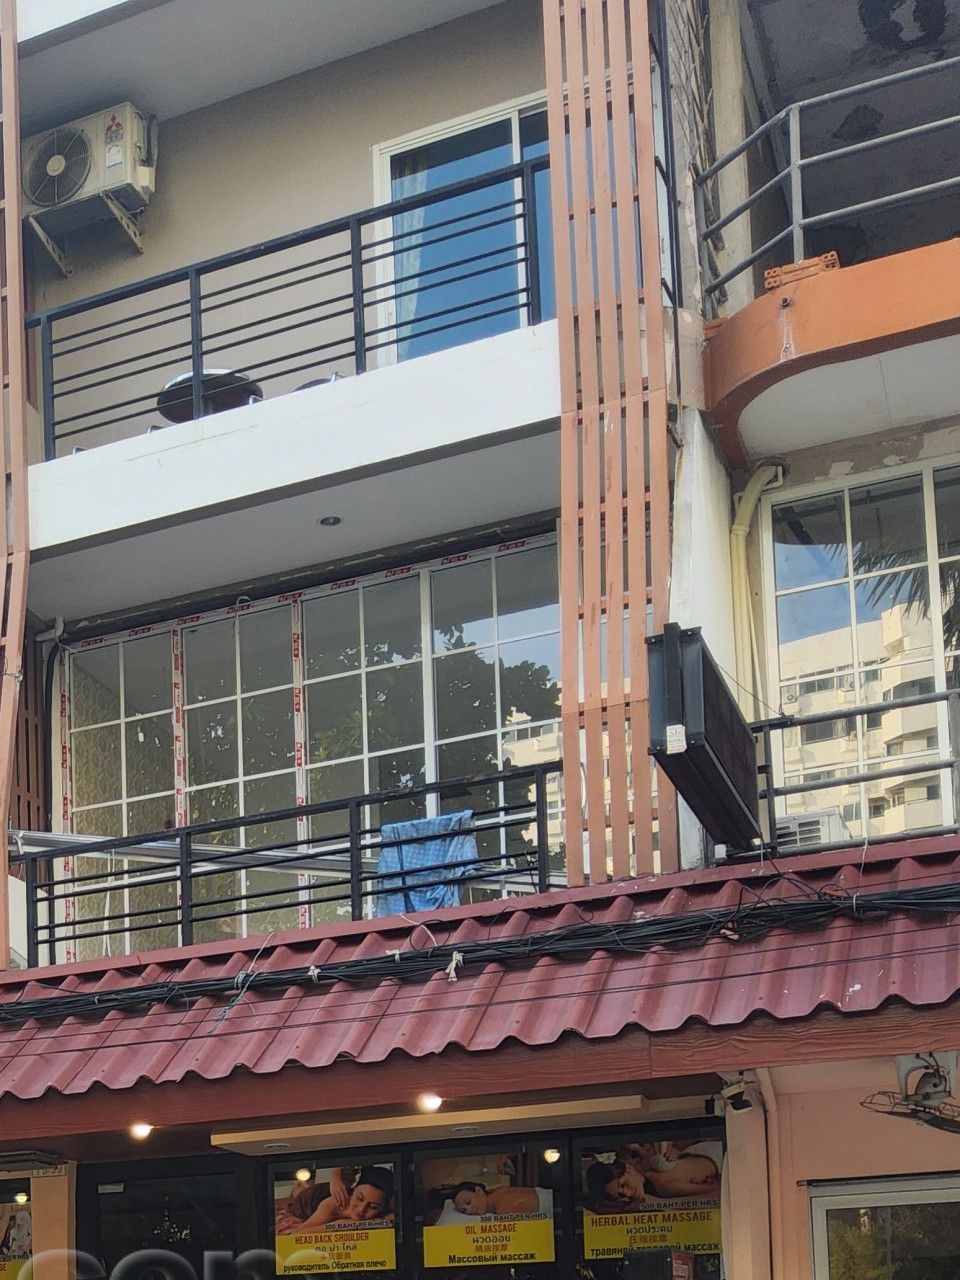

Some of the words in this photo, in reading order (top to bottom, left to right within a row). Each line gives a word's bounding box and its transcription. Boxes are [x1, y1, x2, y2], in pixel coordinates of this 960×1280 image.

[591, 1216, 630, 1227] HERBAL
[633, 1214, 658, 1225] HEAT
[662, 1211, 712, 1223] MASSAGE
[465, 1226, 477, 1235] OIL
[480, 1223, 517, 1234] MASSAGE
[295, 1235, 314, 1245] HEAD
[314, 1233, 332, 1244] BACK
[334, 1232, 369, 1243] SHOULDER
[448, 1253, 498, 1264] Массовый
[500, 1252, 536, 1261] массаж
